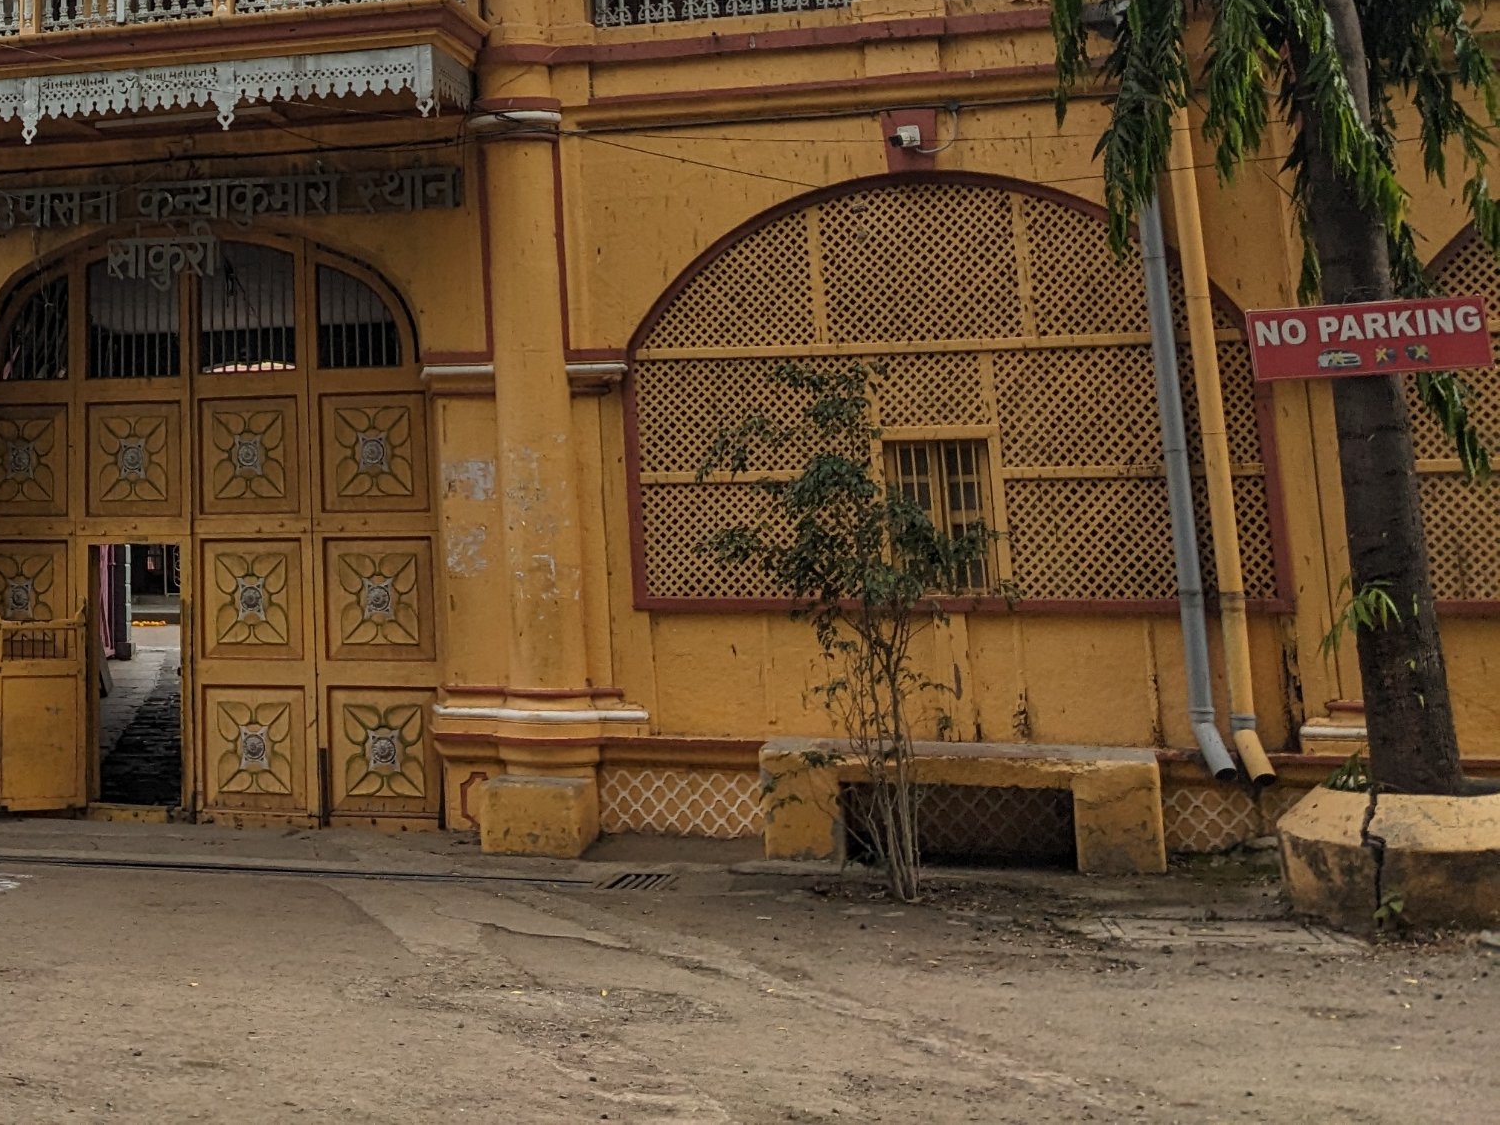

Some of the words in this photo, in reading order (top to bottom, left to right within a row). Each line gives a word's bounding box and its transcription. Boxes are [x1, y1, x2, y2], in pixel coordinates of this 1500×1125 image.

[107, 220, 219, 292] साकुरी
[1254, 318, 1307, 347] NO
[1317, 305, 1482, 343] PARKING
